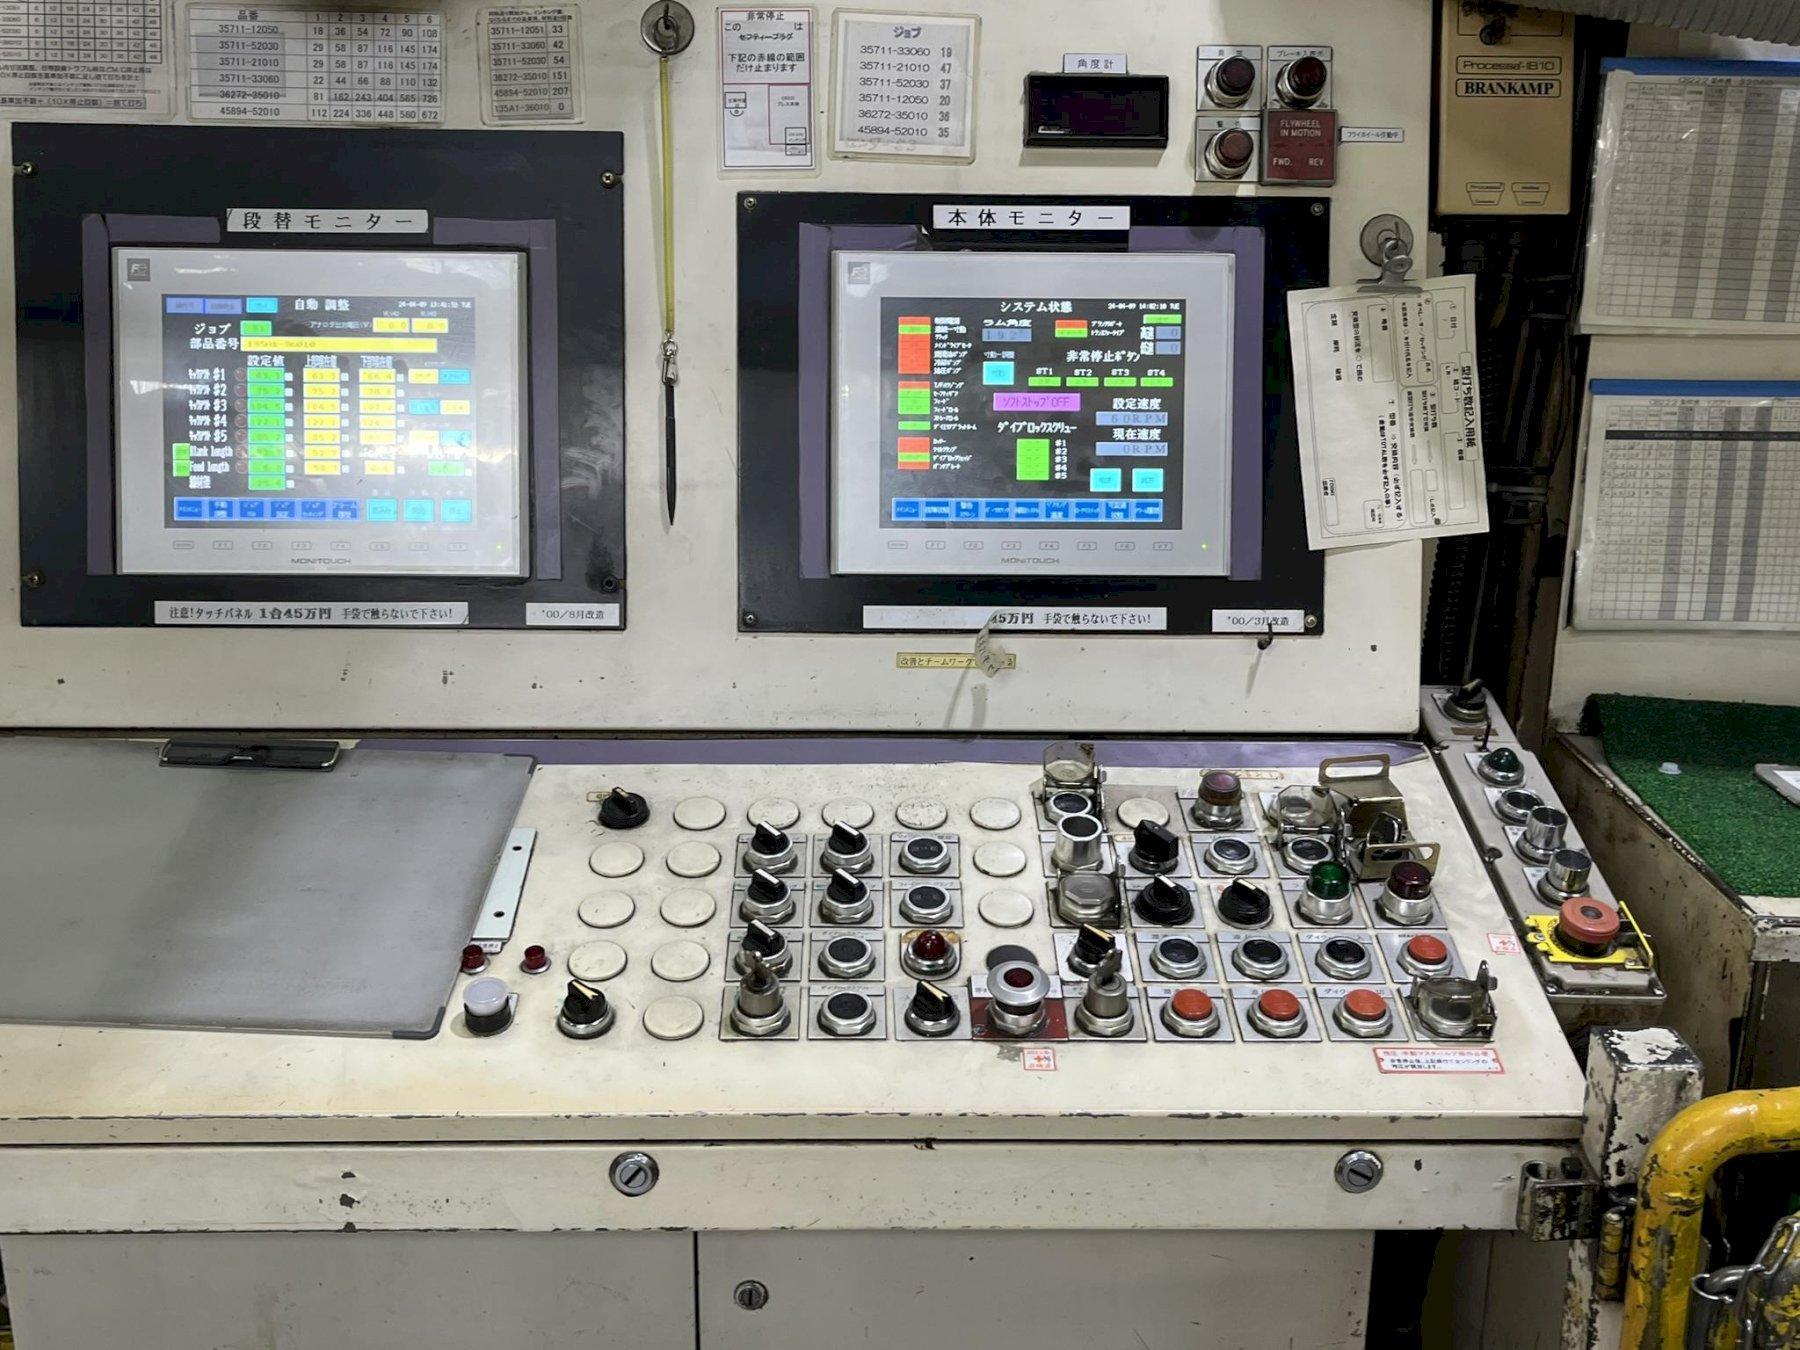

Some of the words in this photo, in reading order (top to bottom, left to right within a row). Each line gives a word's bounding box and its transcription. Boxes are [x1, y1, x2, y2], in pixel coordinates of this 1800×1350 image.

[747, 12, 785, 21] 非常停止
[313, 27, 323, 35] 18
[335, 28, 346, 36] 36
[357, 28, 368, 36] 54
[380, 29, 391, 37] 72
[402, 29, 413, 37] 90
[552, 25, 562, 33] 33
[725, 23, 741, 31] この
[794, 23, 803, 31] は
[893, 26, 922, 38] ジョブ
[335, 43, 346, 52] 58
[357, 44, 368, 52] 87
[400, 46, 416, 54] 145
[422, 46, 438, 54] 174
[553, 41, 563, 49] 42
[860, 45, 930, 56] 35711-33060
[554, 56, 564, 64] 54
[728, 53, 805, 63] 下記の赤線の範囲
[313, 60, 323, 68] 29
[335, 61, 346, 69] 58
[357, 61, 368, 69] 87
[400, 62, 416, 70] 145
[736, 63, 797, 73] だけ止まります
[859, 61, 929, 72] 35711-21010
[940, 63, 951, 74] 47
[1077, 59, 1114, 69] 角度計
[313, 76, 323, 84] 22
[335, 77, 346, 85] 44
[380, 78, 391, 86] 88
[400, 78, 416, 86] 110
[422, 79, 438, 87] 132
[553, 72, 567, 80] 151
[859, 78, 929, 88] 35711-52030
[940, 79, 951, 90] 37
[1465, 82, 1554, 95] BRANKAMP
[553, 87, 568, 95] 207
[313, 92, 323, 100] 81
[355, 94, 372, 102] 243
[422, 95, 438, 103] 726
[859, 94, 929, 104] 35711-12050
[939, 96, 950, 106] 20
[312, 109, 327, 117] 112
[334, 110, 349, 118] 224
[355, 110, 372, 118] 336
[378, 111, 393, 119] 448
[422, 111, 438, 119] 672
[858, 110, 928, 121] 36272-35010
[857, 126, 927, 137] 45894-52010
[938, 128, 949, 138] 35
[1291, 129, 1321, 137] MOTION
[243, 211, 412, 230] 段替モニター
[948, 208, 1114, 226] 本体モニター
[1000, 301, 1072, 313] システム状態
[194, 322, 231, 335] ジョブ
[190, 337, 239, 350] 部品番号
[247, 355, 285, 366] 設定値
[1113, 398, 1162, 410] 設定速度
[1461, 366, 1477, 448] 型打ち数記入用紙
[1112, 428, 1162, 440] 現在速度
